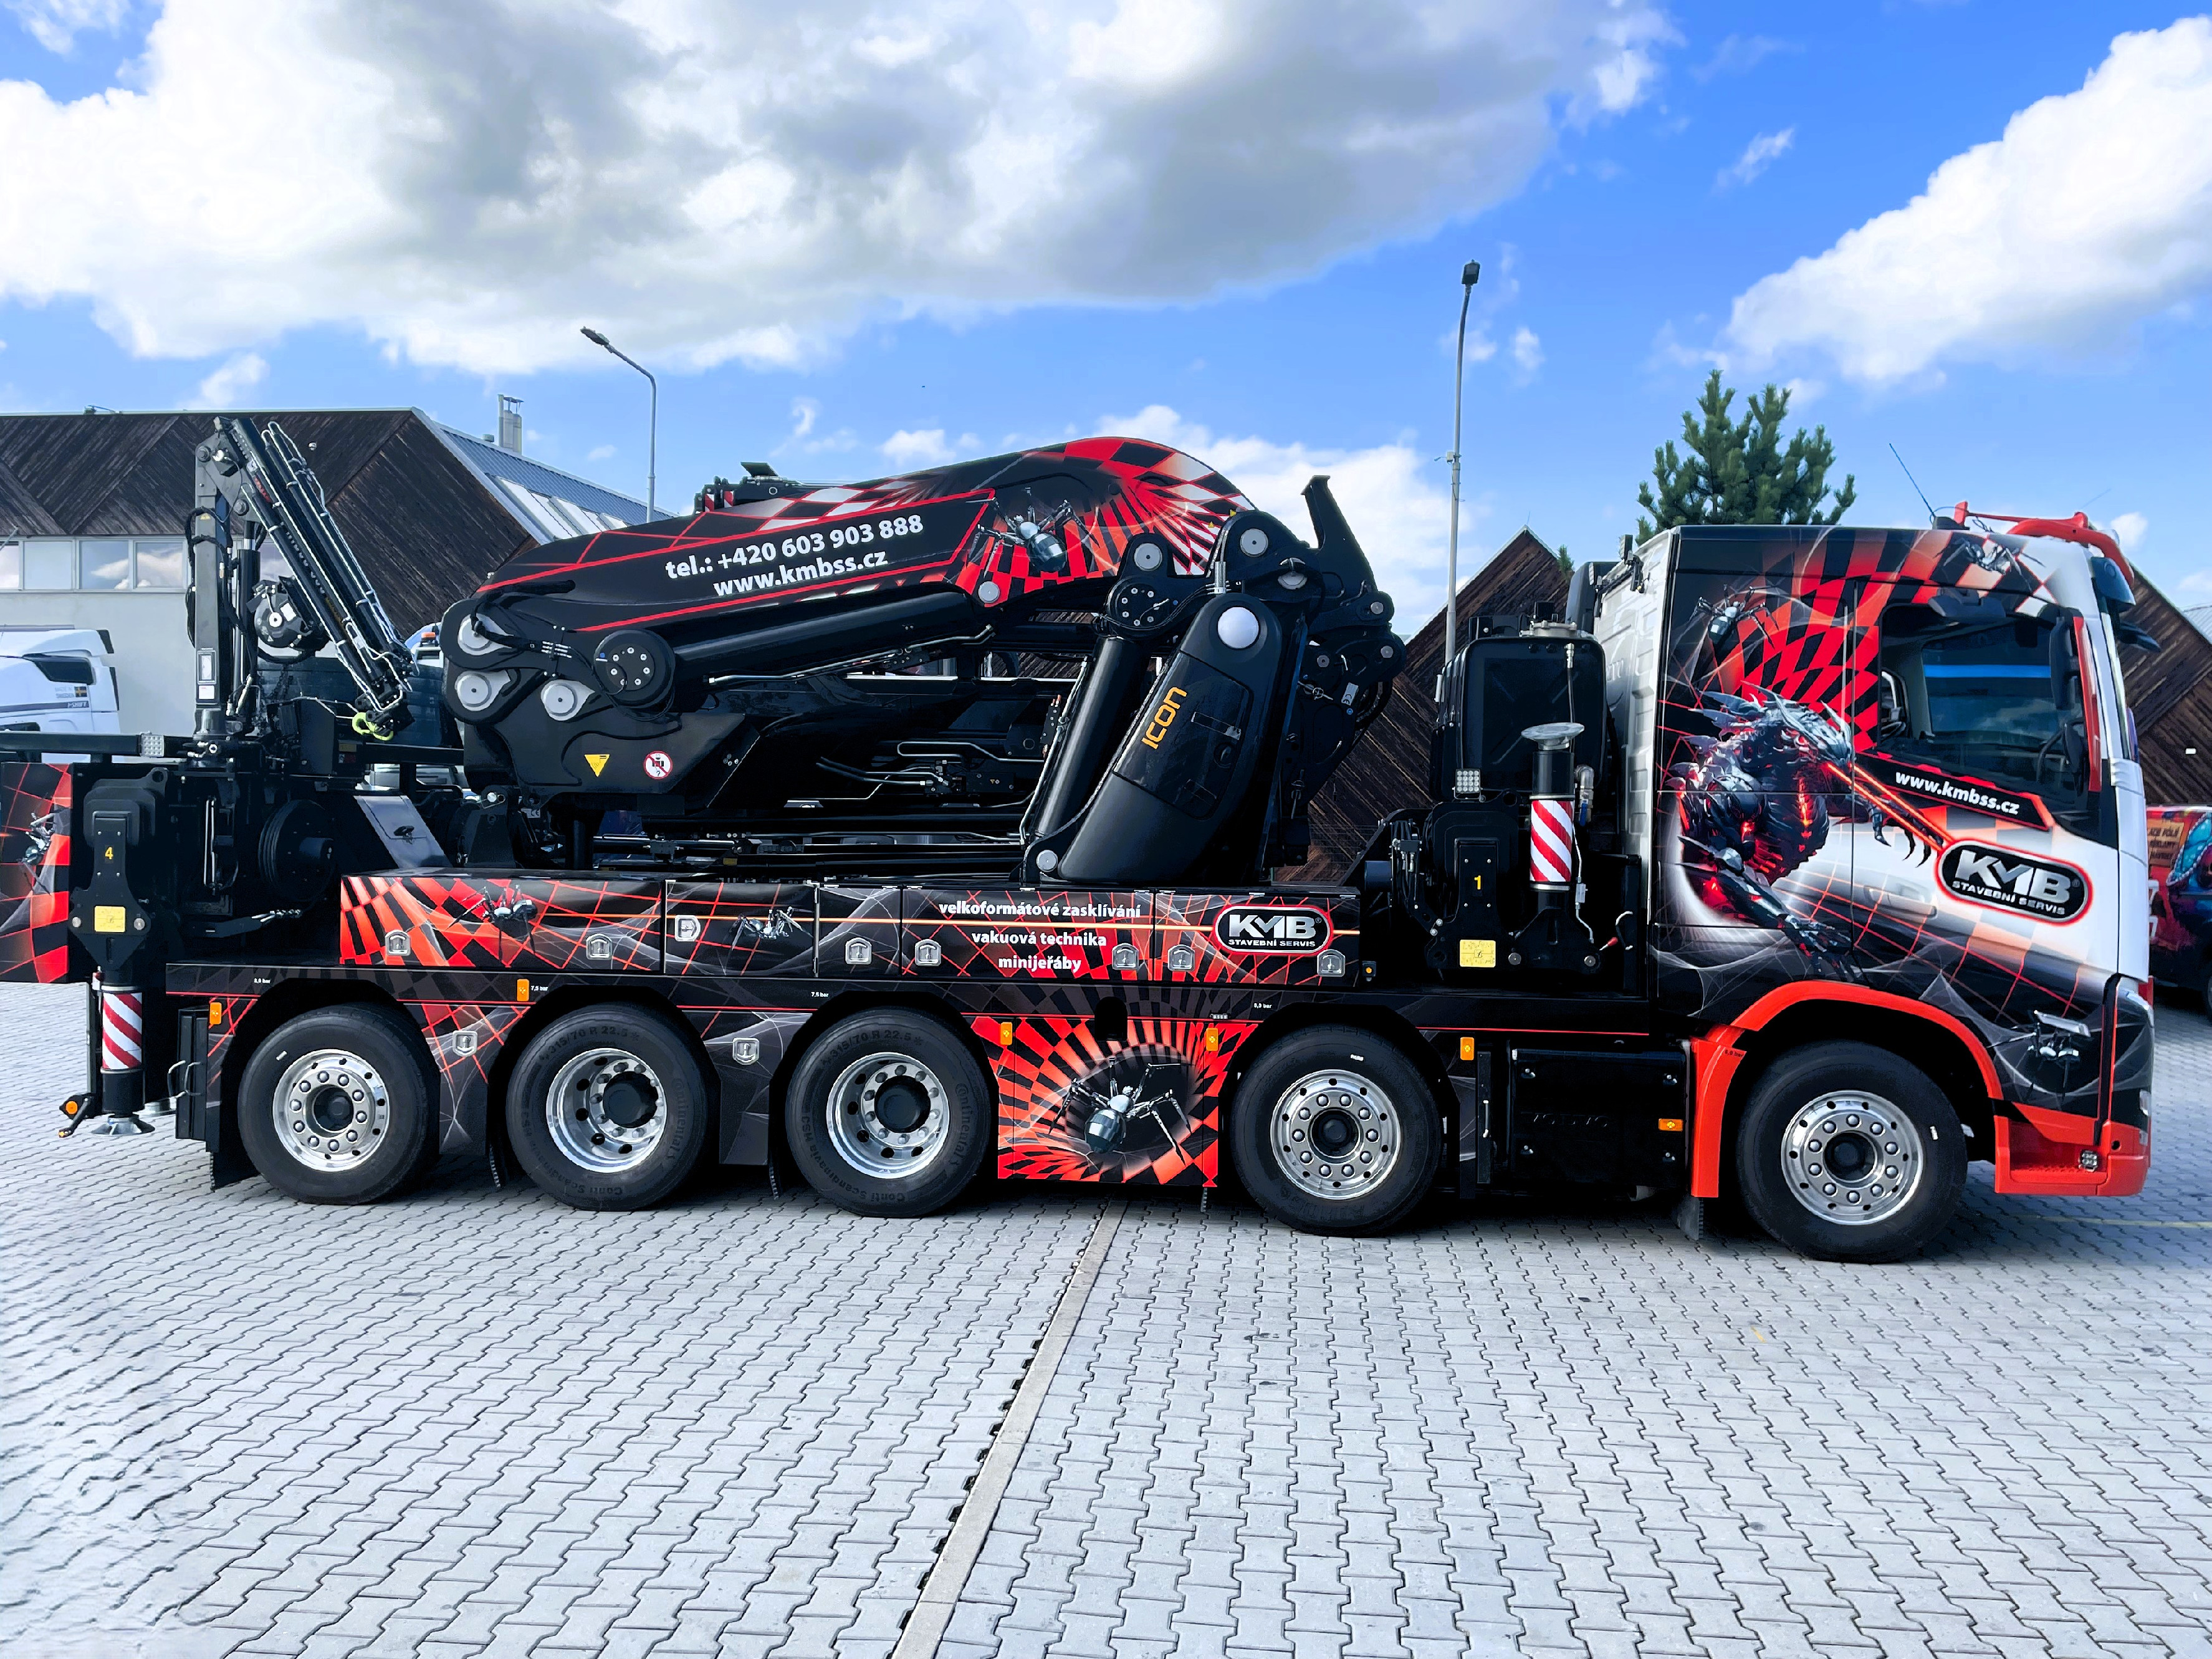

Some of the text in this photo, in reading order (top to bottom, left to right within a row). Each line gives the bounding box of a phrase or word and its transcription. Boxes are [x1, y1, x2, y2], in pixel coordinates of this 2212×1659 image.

[665, 514, 924, 579] tel.: +420 603 903 888
[713, 551, 888, 597] www.kmbss.cz
[1895, 772, 2020, 815] www.kmbss.cz
[105, 847, 114, 860] 4
[1474, 875, 1482, 890] 1
[1955, 849, 2072, 904] KMB
[939, 901, 1141, 918] velkoformátové zasklívání
[2018, 897, 2066, 915] SERVIS
[1228, 914, 1316, 939] KMB
[971, 930, 1107, 946] vakuová technika
[998, 955, 1082, 972] minijeřáby
[884, 1029, 912, 1041] 22.5
